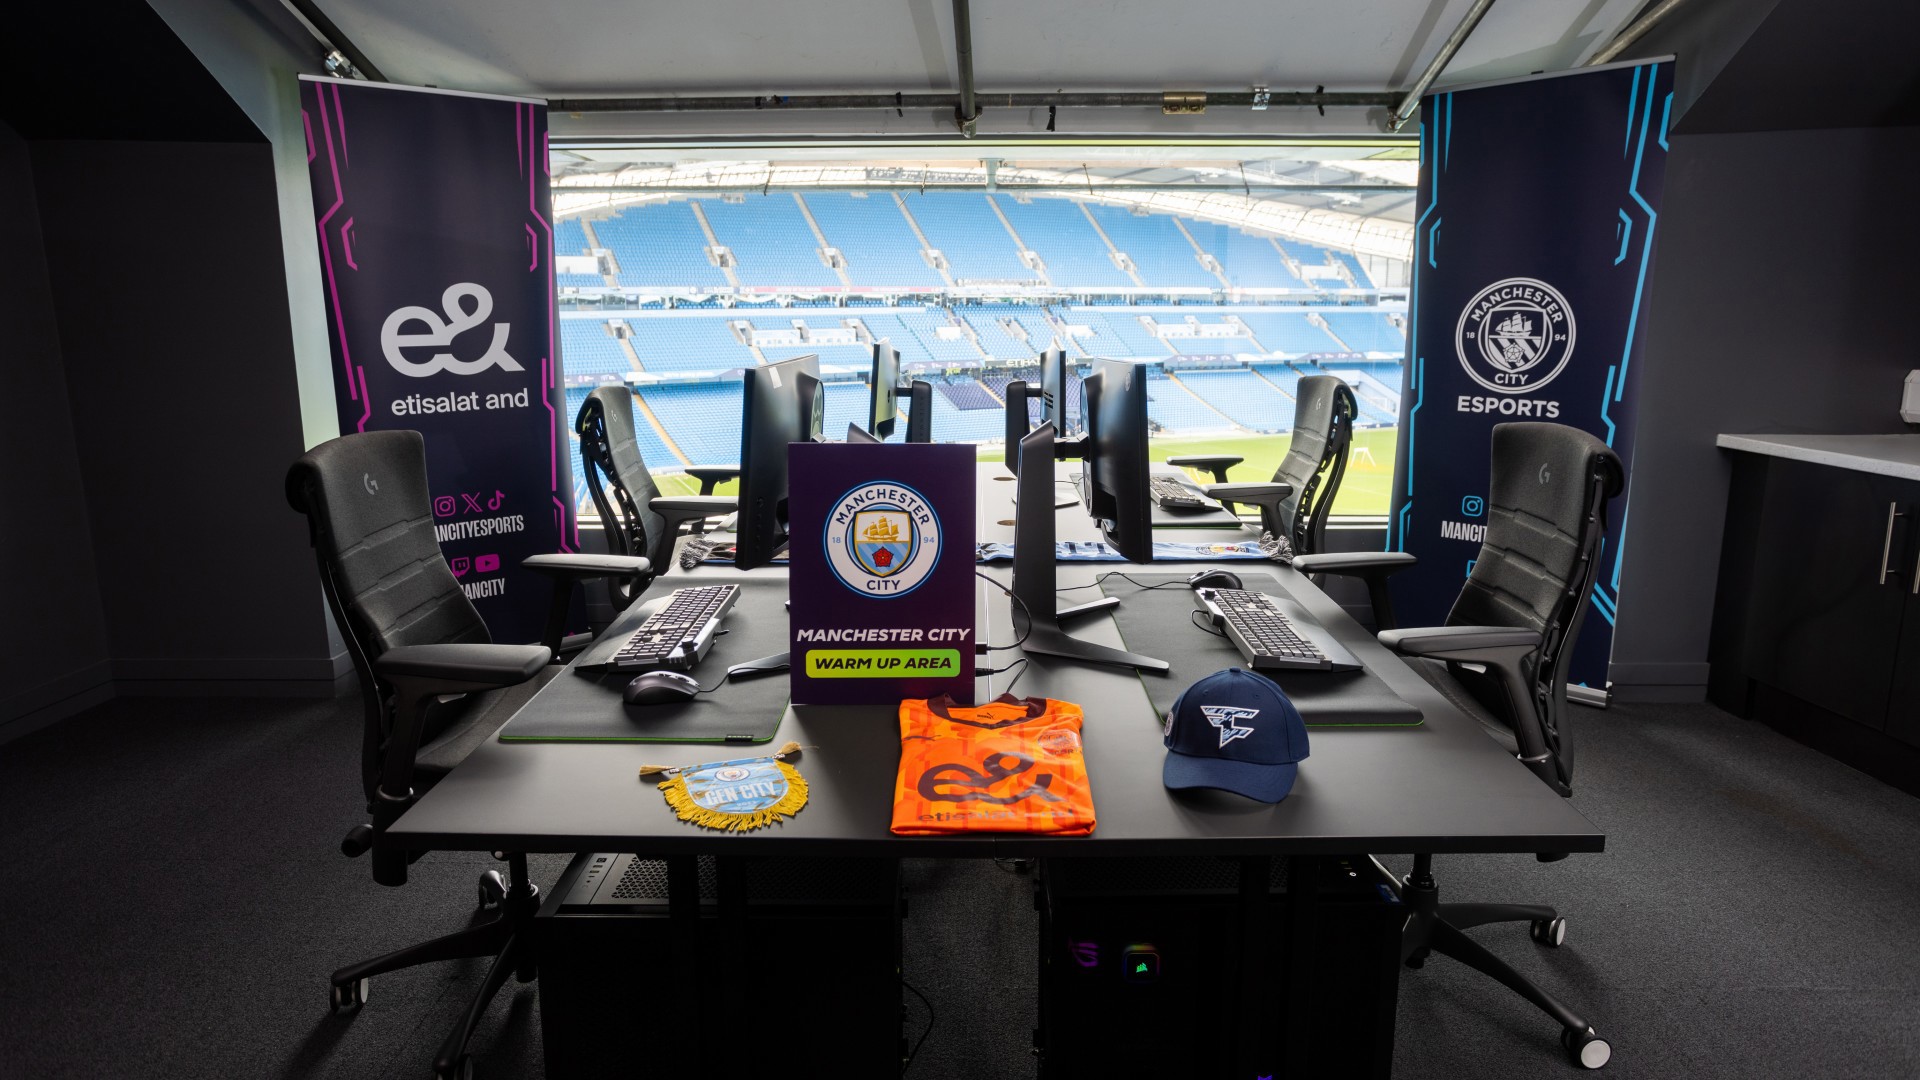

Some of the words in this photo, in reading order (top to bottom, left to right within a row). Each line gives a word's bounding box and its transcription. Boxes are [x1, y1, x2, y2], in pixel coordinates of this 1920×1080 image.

[1471, 287, 1563, 323] MANCHESTER
[1006, 359, 1040, 367] ETIHA
[1494, 373, 1529, 385] CITY
[391, 391, 480, 416] etisalat
[485, 387, 529, 410] and
[1457, 395, 1560, 418] ESPORTS
[835, 489, 930, 525] MANCHESTER
[434, 515, 524, 542] NCITYESPORTS
[832, 536, 841, 544] 18
[923, 536, 935, 544] 94
[460, 578, 505, 600] ANCITY
[866, 580, 901, 591] CITY
[797, 629, 922, 642] MANCHESTER
[928, 628, 970, 642] CITY
[815, 657, 871, 670] WARM
[876, 657, 902, 669] UP
[904, 657, 952, 669] AREA
[705, 785, 739, 805] GEN
[739, 781, 776, 799] CITY
